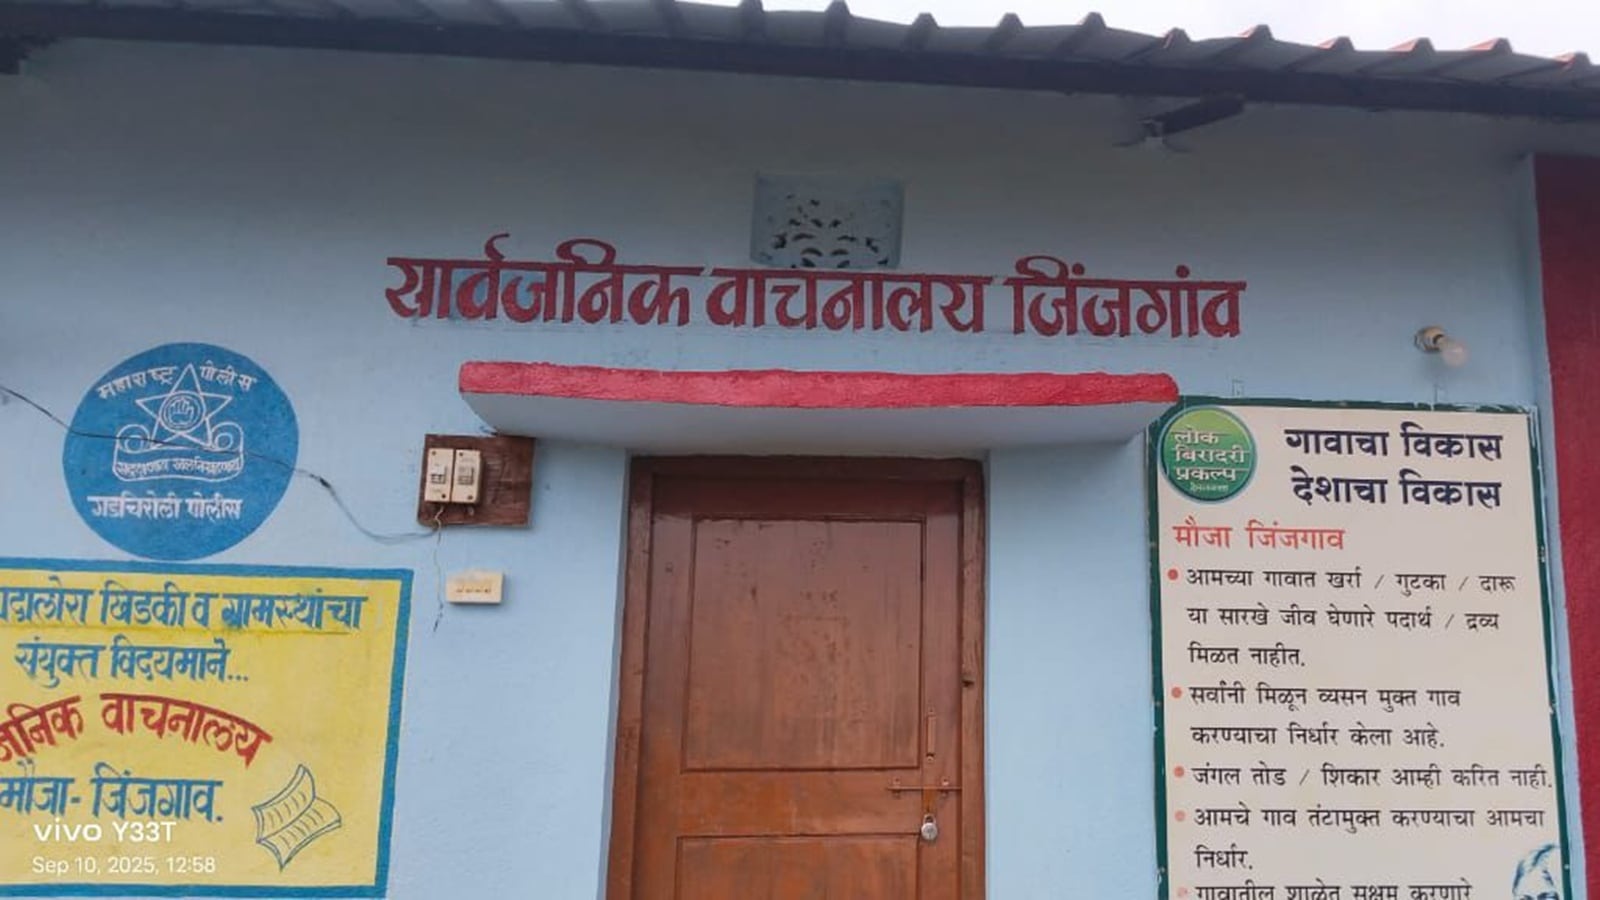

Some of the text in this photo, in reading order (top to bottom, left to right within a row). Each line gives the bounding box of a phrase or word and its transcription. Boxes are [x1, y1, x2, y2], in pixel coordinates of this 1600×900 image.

[385, 233, 1247, 338] सार्वजनिक वाचनालय जिंजगांव
[1173, 424, 1224, 444] लोक
[1284, 421, 1503, 460] गावाचा विकास
[1173, 444, 1246, 464] बिरादरी
[1174, 466, 1241, 481] प्रकल्प
[1290, 465, 1501, 509] देशाचा विकास
[1172, 514, 1345, 550] मौजा जिंजगाव
[1187, 569, 1253, 586] आमच्या
[1263, 571, 1317, 587] गावात
[1326, 566, 1362, 588] खर्रा
[1395, 574, 1446, 597] गुटका
[1479, 575, 1516, 593] दारू
[99, 580, 190, 630] खिडकी
[191, 593, 219, 629] व
[1187, 607, 1208, 624] या
[1217, 602, 1269, 625] सारखे
[1279, 604, 1317, 626] जीव
[1326, 603, 1375, 628] घेणारे
[1384, 606, 1432, 630] पदार्थ
[1464, 613, 1500, 632] द्रव्य
[15, 636, 106, 688] संयुक्त
[1187, 641, 1305, 667] मिळत नाहीत.
[1189, 680, 1461, 713] सर्वांनी मिळून व्यसन मुक्त गाव
[100, 693, 273, 768] वाचनालय
[1190, 721, 1445, 749] करण्याचा निर्धार केला आहे.
[1191, 761, 1241, 785] जंगल
[1250, 761, 1287, 786] तोड
[1320, 762, 1381, 787] शिकार
[1392, 763, 1441, 789] आम्ही
[1450, 764, 1499, 787] करित
[1509, 764, 1553, 789] नाही.
[1194, 801, 1545, 834] आमचे गाव तंटामुक्त करण्याचा आमचा
[1194, 843, 1253, 870] निर्धार.
[1195, 879, 1275, 900] गावातील
